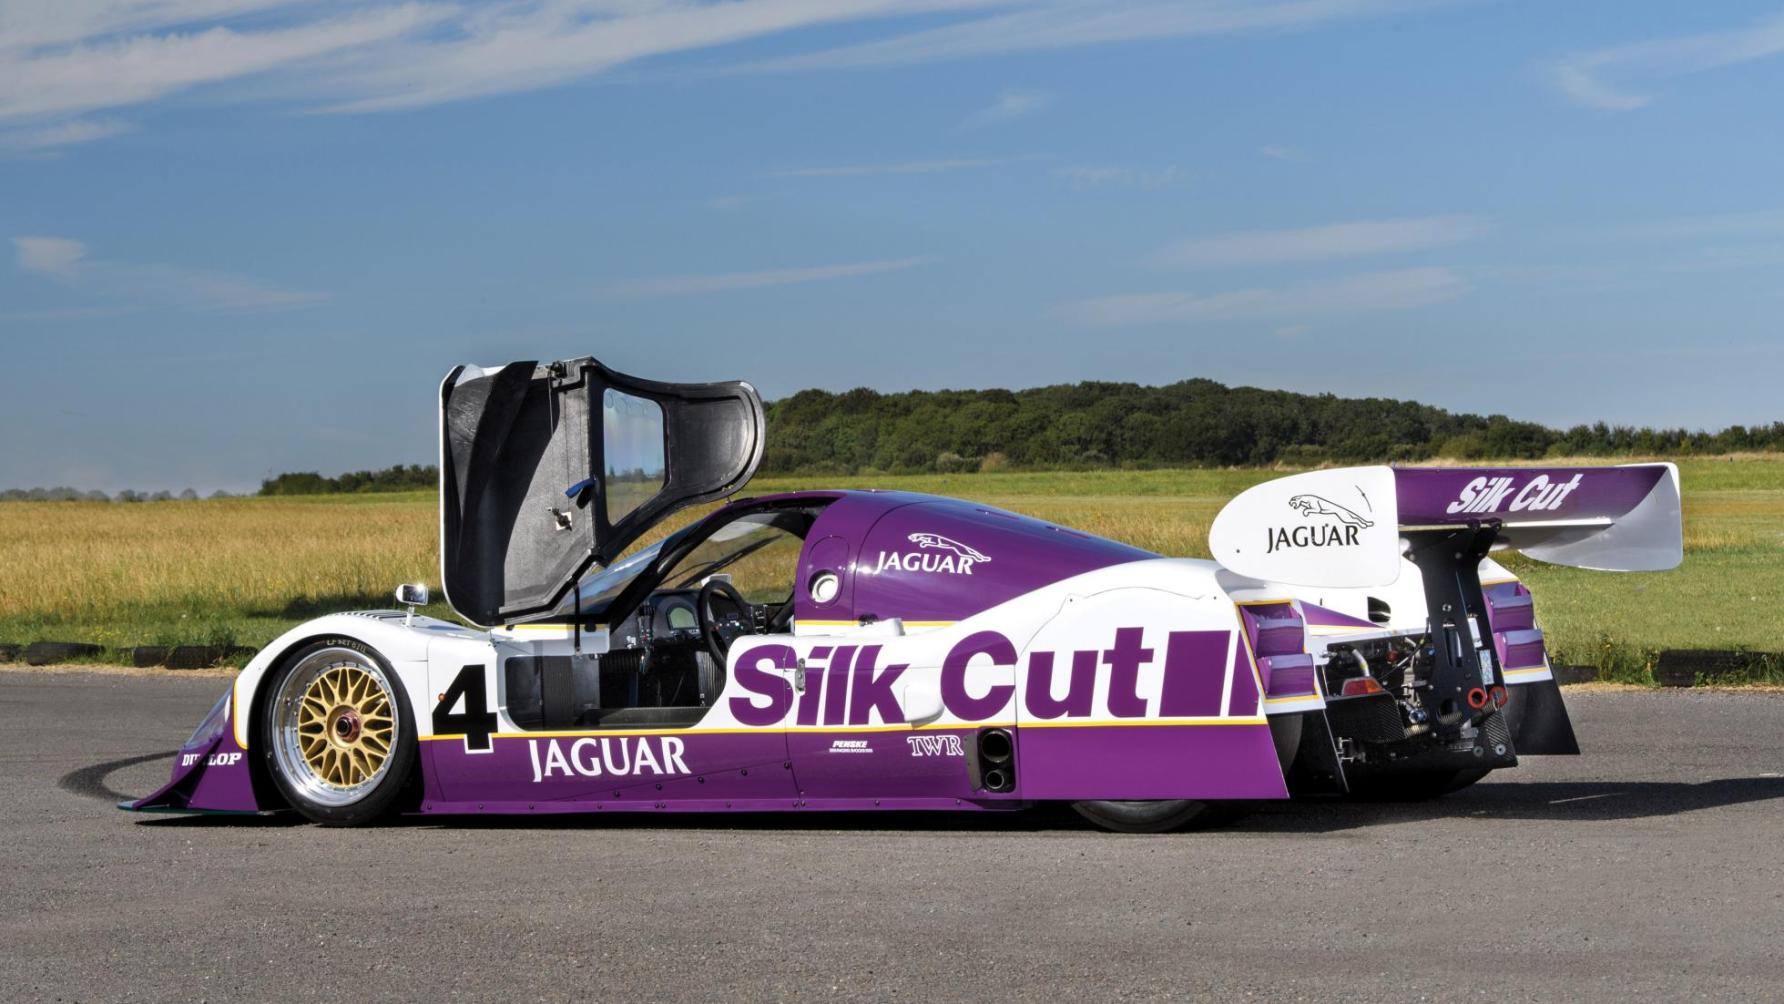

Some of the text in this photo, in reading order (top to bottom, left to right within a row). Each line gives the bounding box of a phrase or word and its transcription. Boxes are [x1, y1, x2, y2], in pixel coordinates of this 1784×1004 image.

[1446, 474, 1584, 514] Silk Cut
[1267, 525, 1360, 553] JAGUAR
[874, 551, 974, 575] JAGUAR
[729, 627, 1156, 726] Silk Cut
[432, 664, 498, 753] 4
[181, 752, 242, 766] DULOP
[528, 737, 692, 783] JAGUAR
[906, 734, 964, 756] TWR
